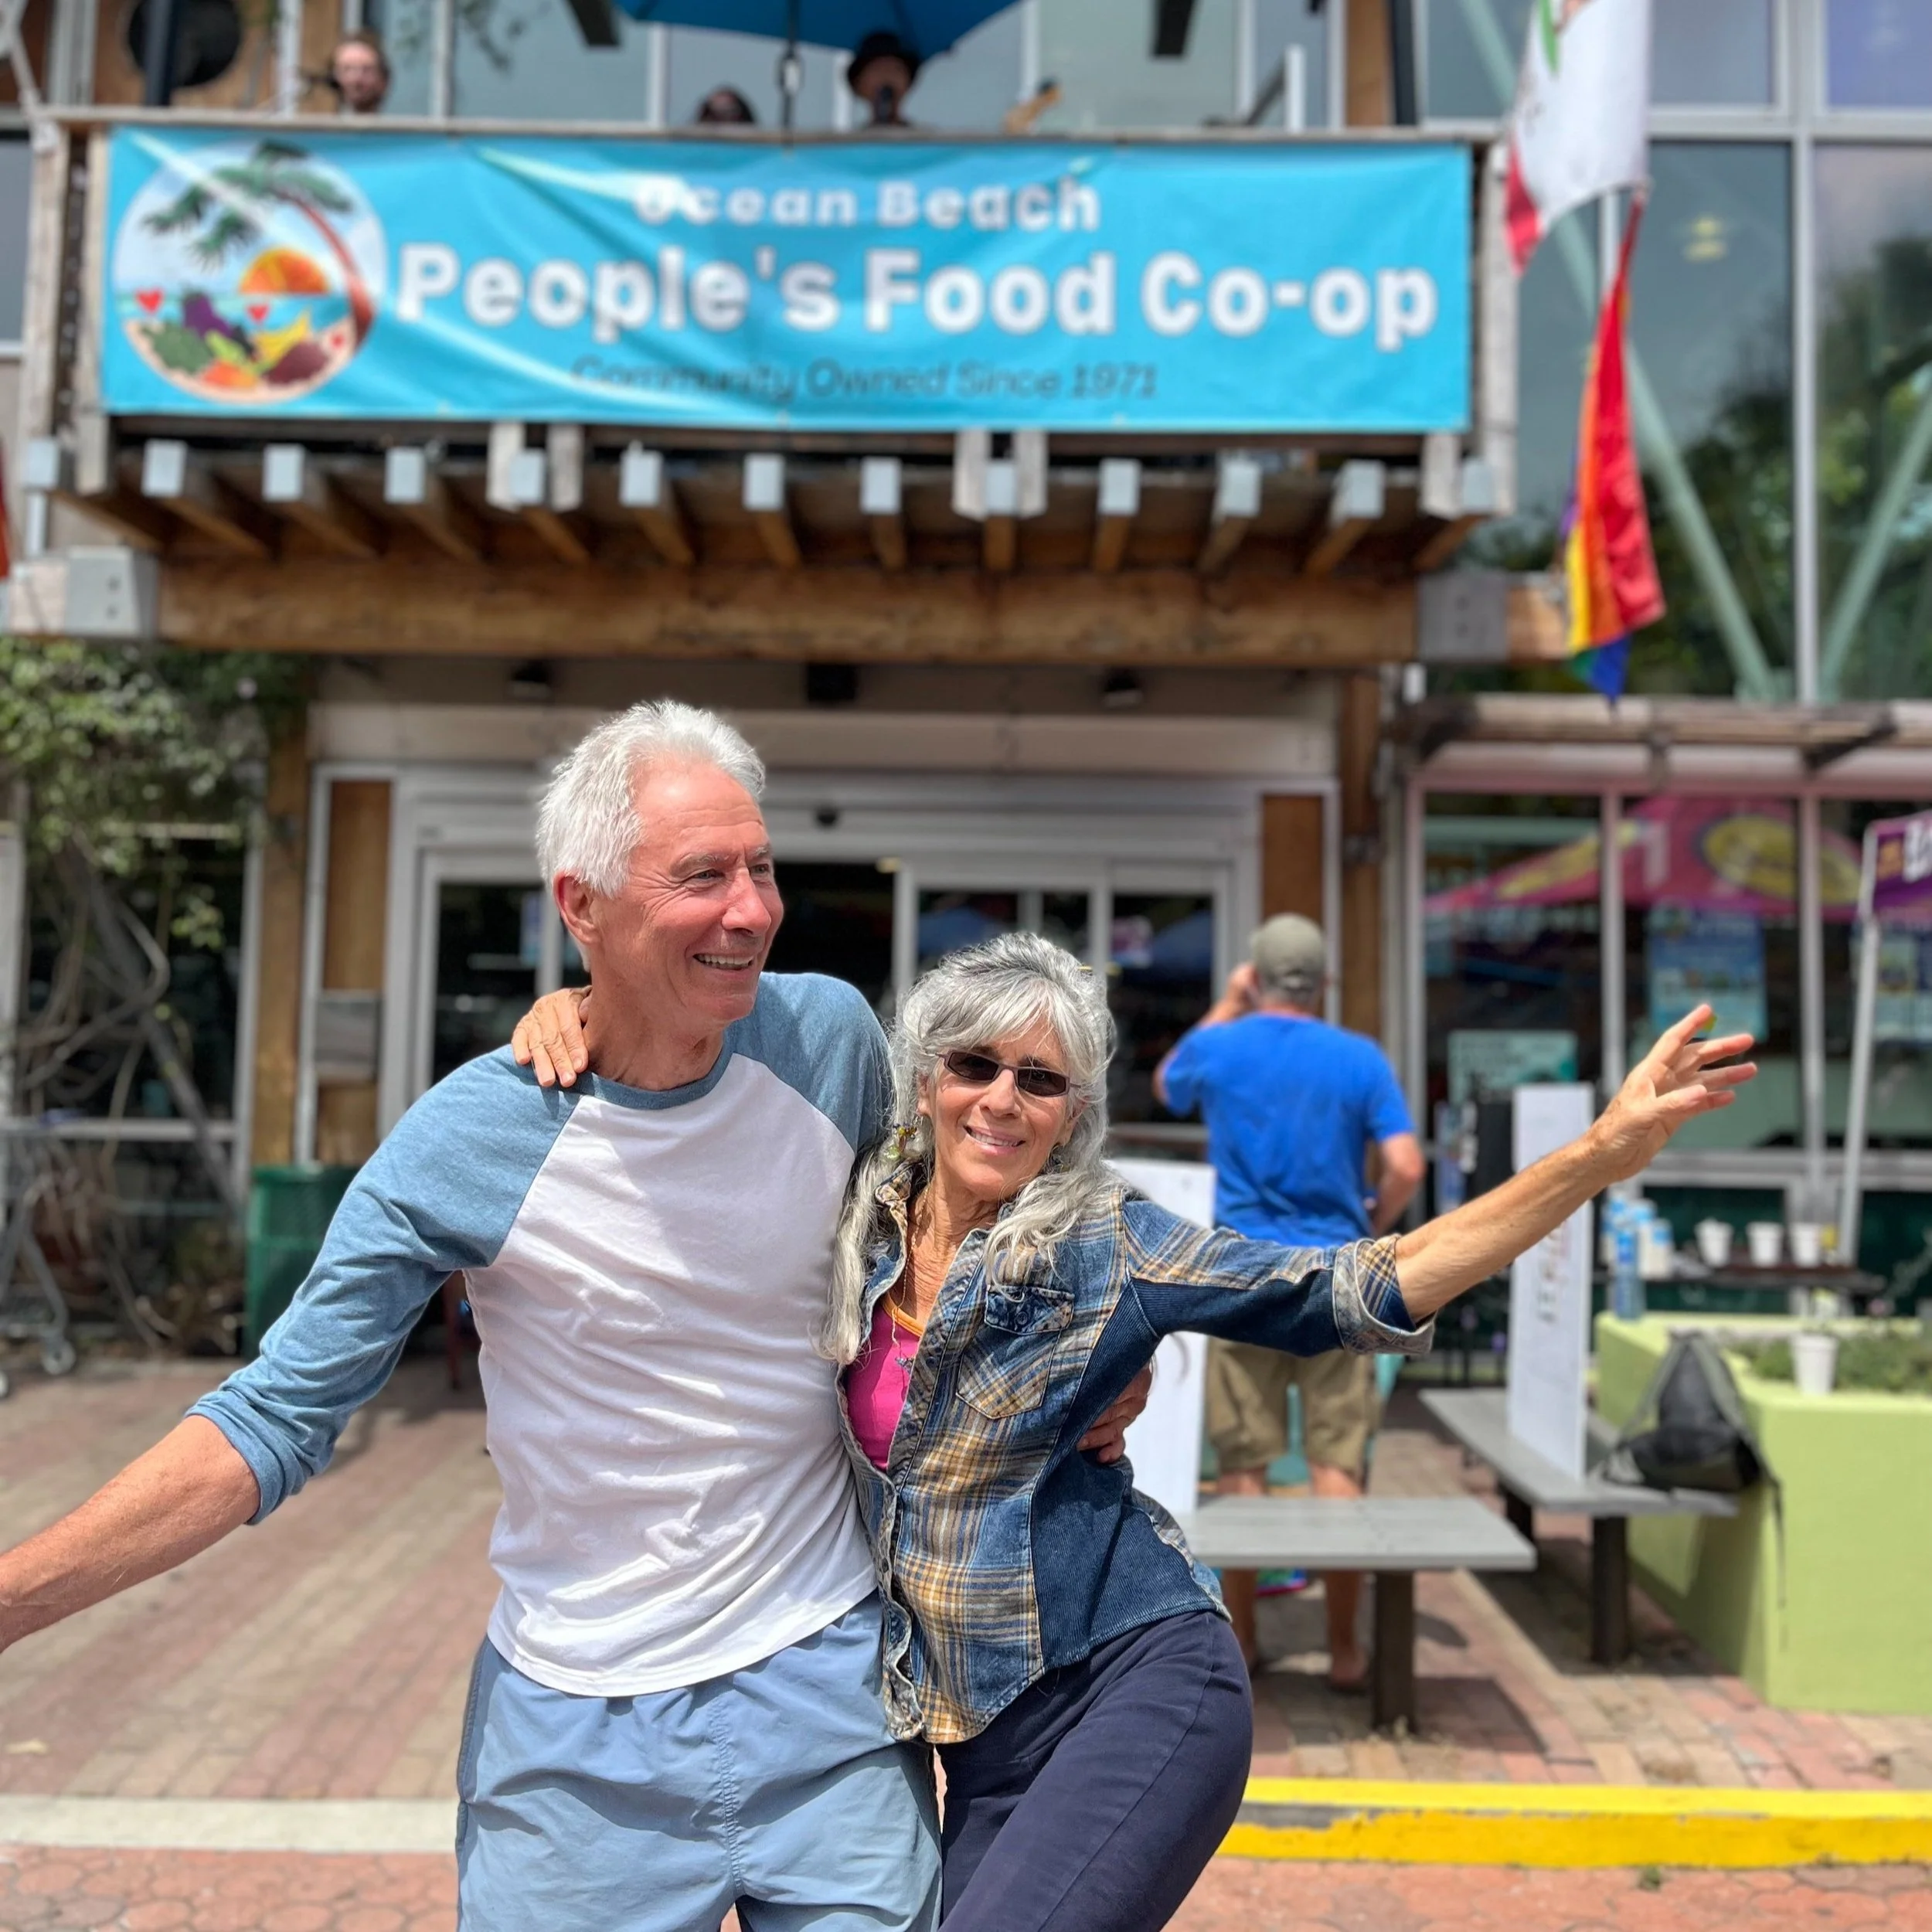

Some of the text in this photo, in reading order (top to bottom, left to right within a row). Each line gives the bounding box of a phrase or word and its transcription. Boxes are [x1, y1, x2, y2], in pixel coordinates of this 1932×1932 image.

[877, 176, 1100, 230] Beach
[395, 241, 1439, 352] People's Food Co-op
[570, 355, 1159, 406] Community Owned Since 1971
